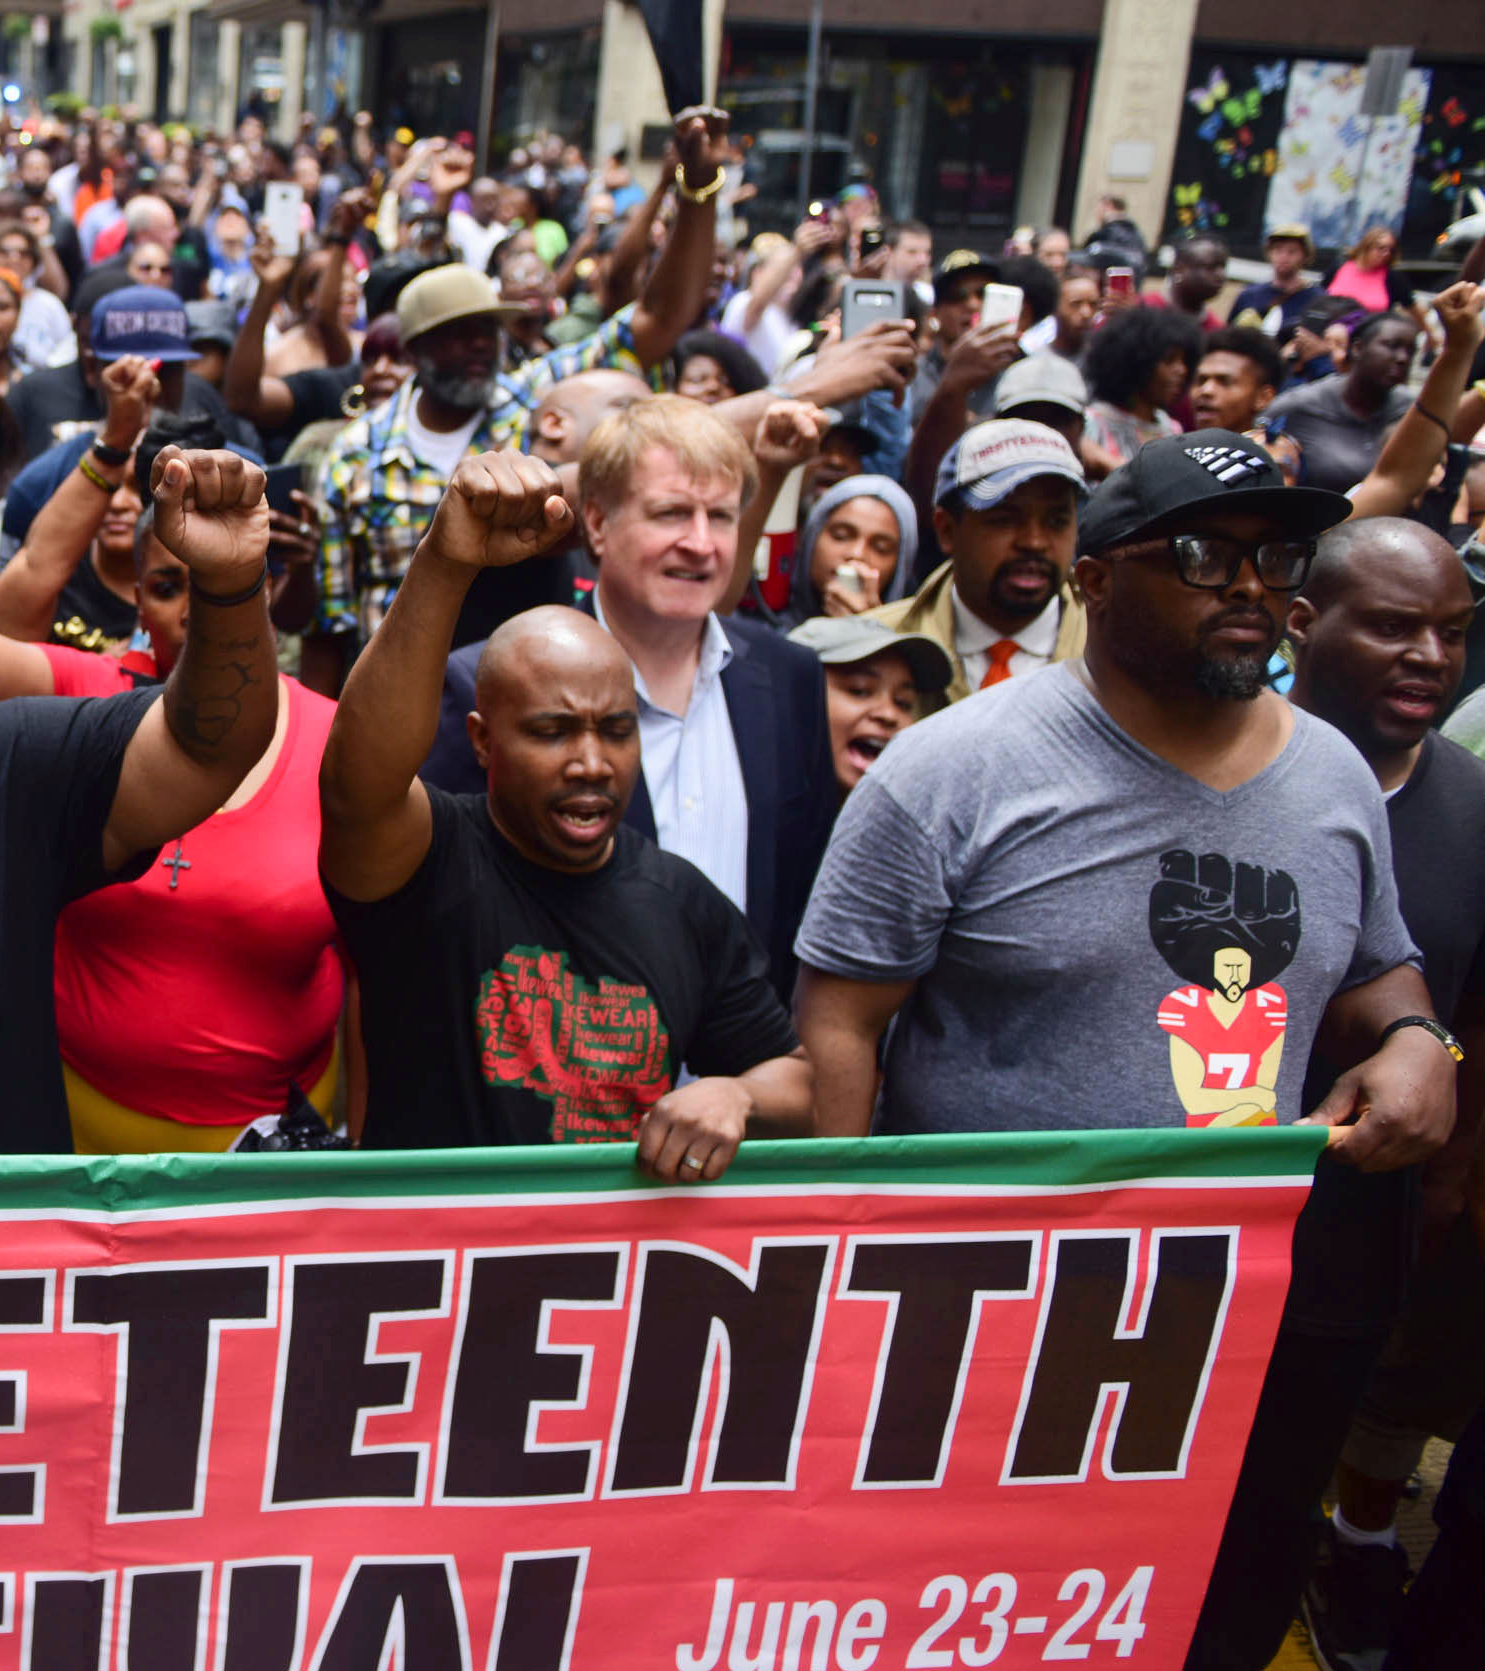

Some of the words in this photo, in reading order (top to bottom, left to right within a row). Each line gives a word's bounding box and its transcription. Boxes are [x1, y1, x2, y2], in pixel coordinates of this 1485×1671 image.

[1208, 1053, 1250, 1089] 7
[675, 1577, 888, 1671] June
[905, 1565, 1156, 1670] 23-24
